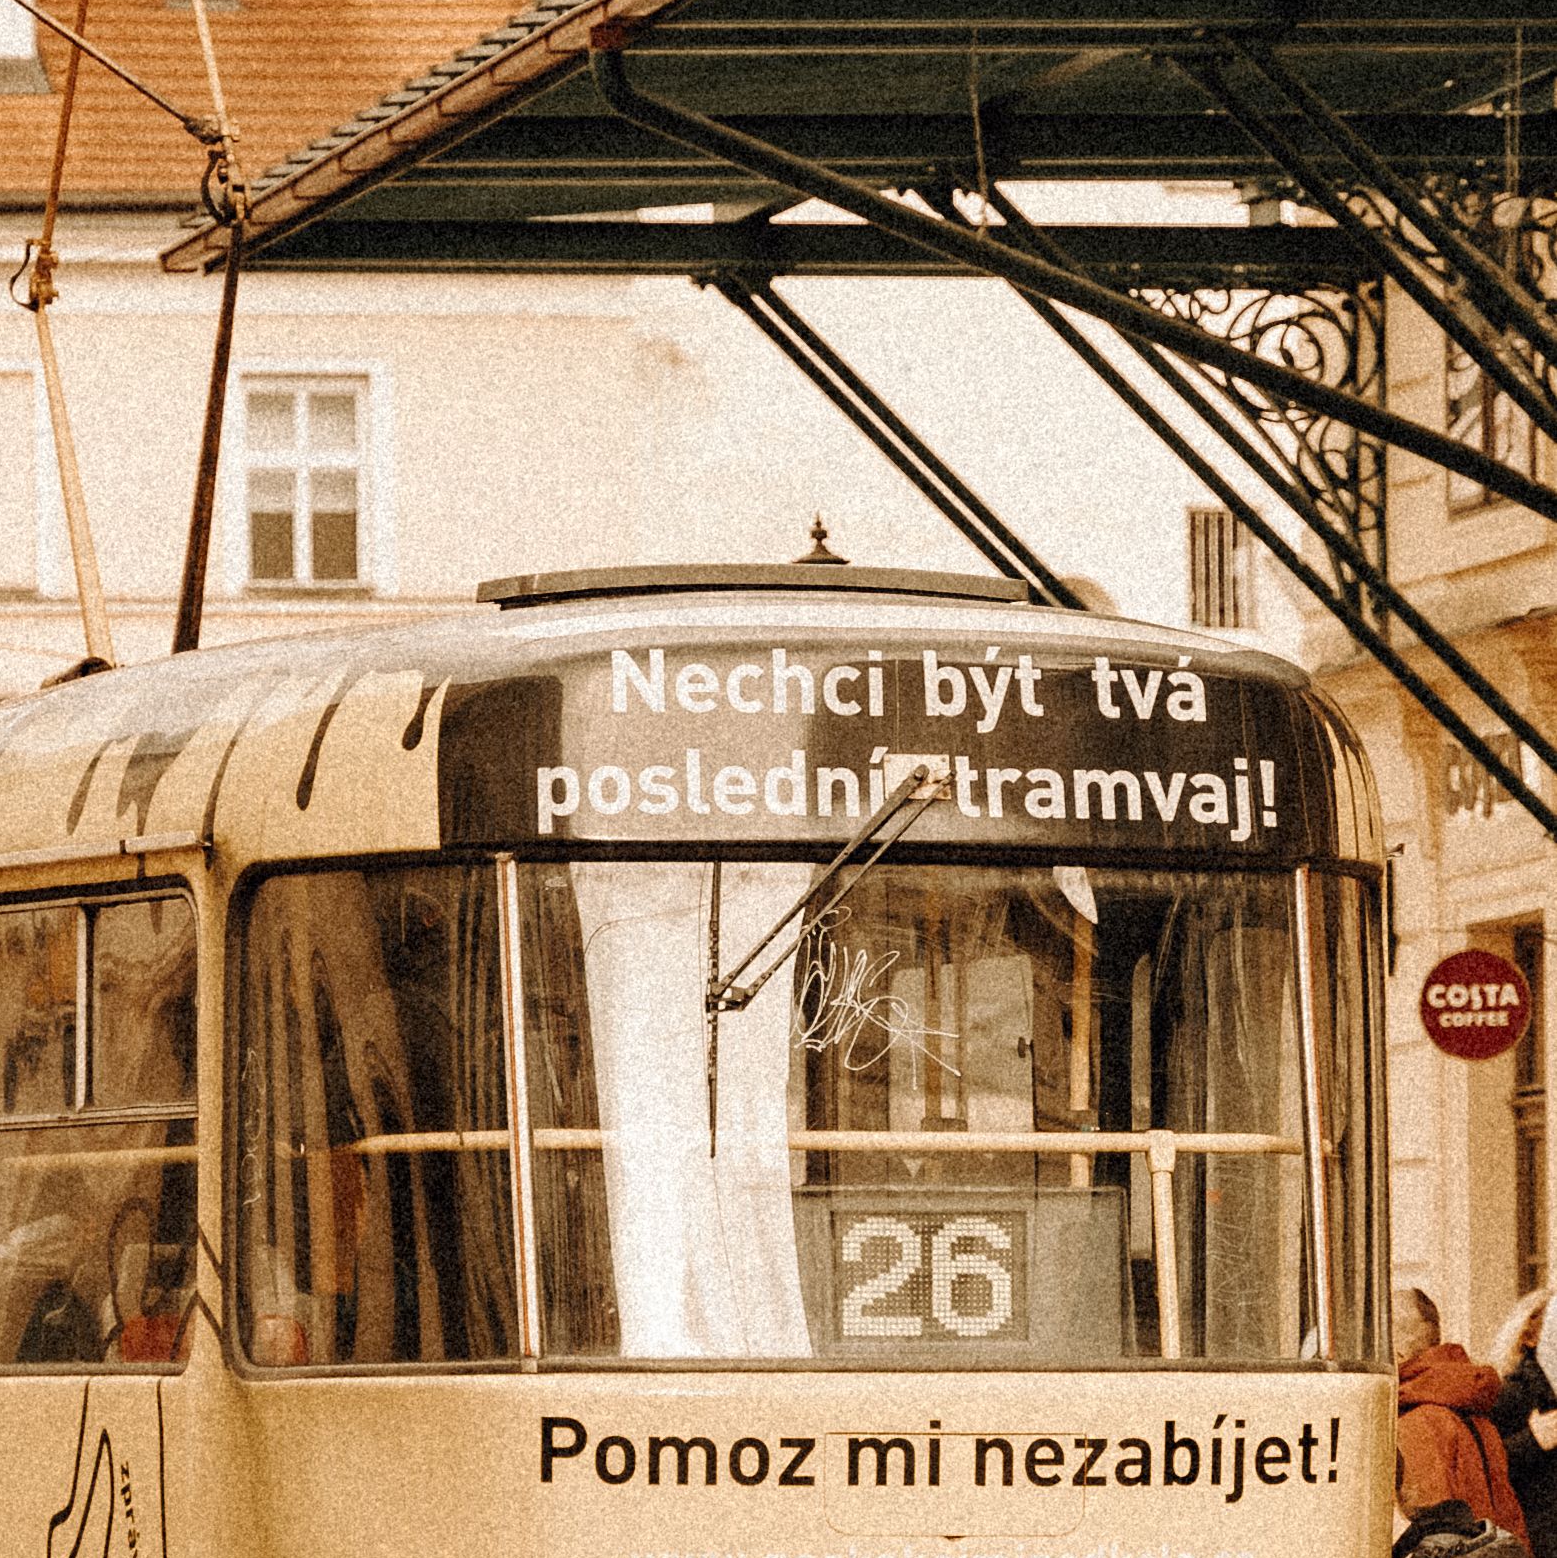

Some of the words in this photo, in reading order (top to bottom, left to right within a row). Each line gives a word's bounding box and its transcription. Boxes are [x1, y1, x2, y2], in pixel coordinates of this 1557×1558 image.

[610, 649, 885, 718] Nechci
[924, 645, 1044, 734] být
[1091, 654, 1208, 723] tvá
[537, 746, 889, 835] poslední
[954, 755, 1279, 842] tramvaj!
[1426, 983, 1520, 1010] COSTA
[1438, 1010, 1510, 1028] COFFEE
[842, 1216, 1013, 1338] 26
[539, 1416, 817, 1489] Pomoz
[846, 1420, 942, 1488] mi
[973, 1413, 1342, 1503] nezabíjet!
